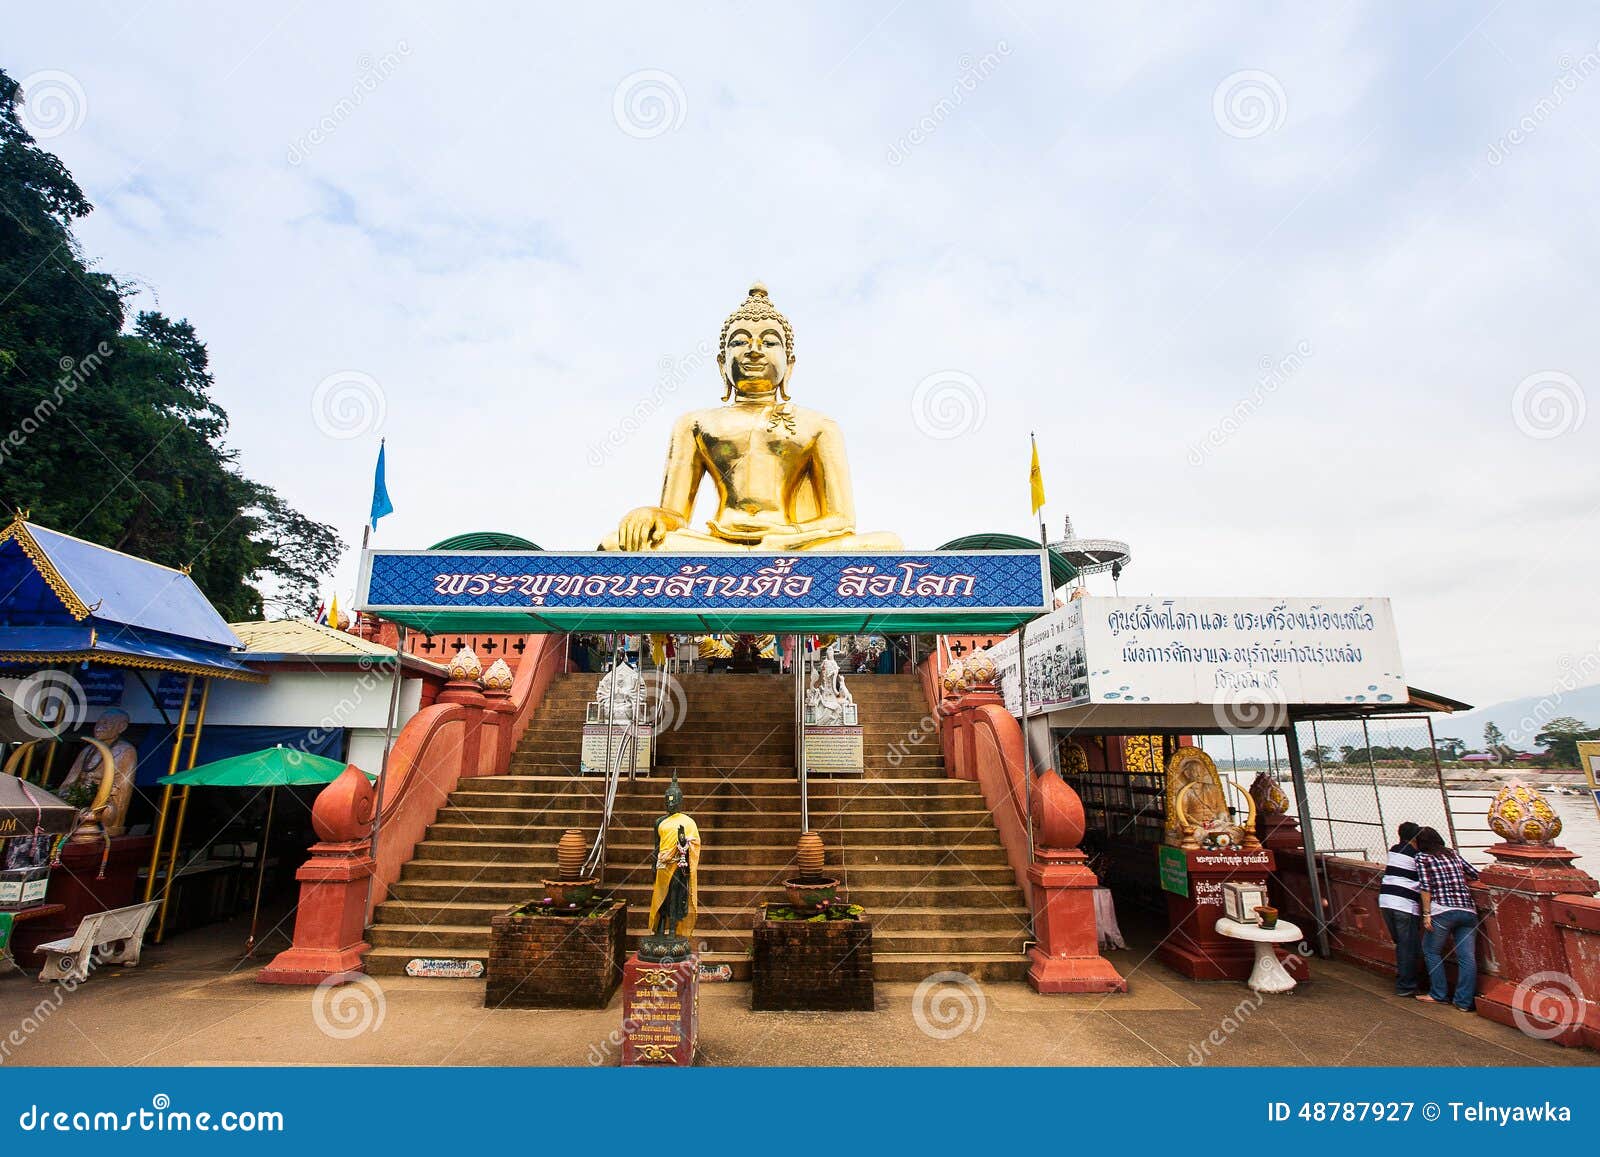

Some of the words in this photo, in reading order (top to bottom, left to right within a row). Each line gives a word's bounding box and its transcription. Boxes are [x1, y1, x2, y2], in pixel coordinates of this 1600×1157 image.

[434, 558, 814, 605] พระพุทธนวล้านตื้อ
[836, 562, 976, 598] ลือโลก
